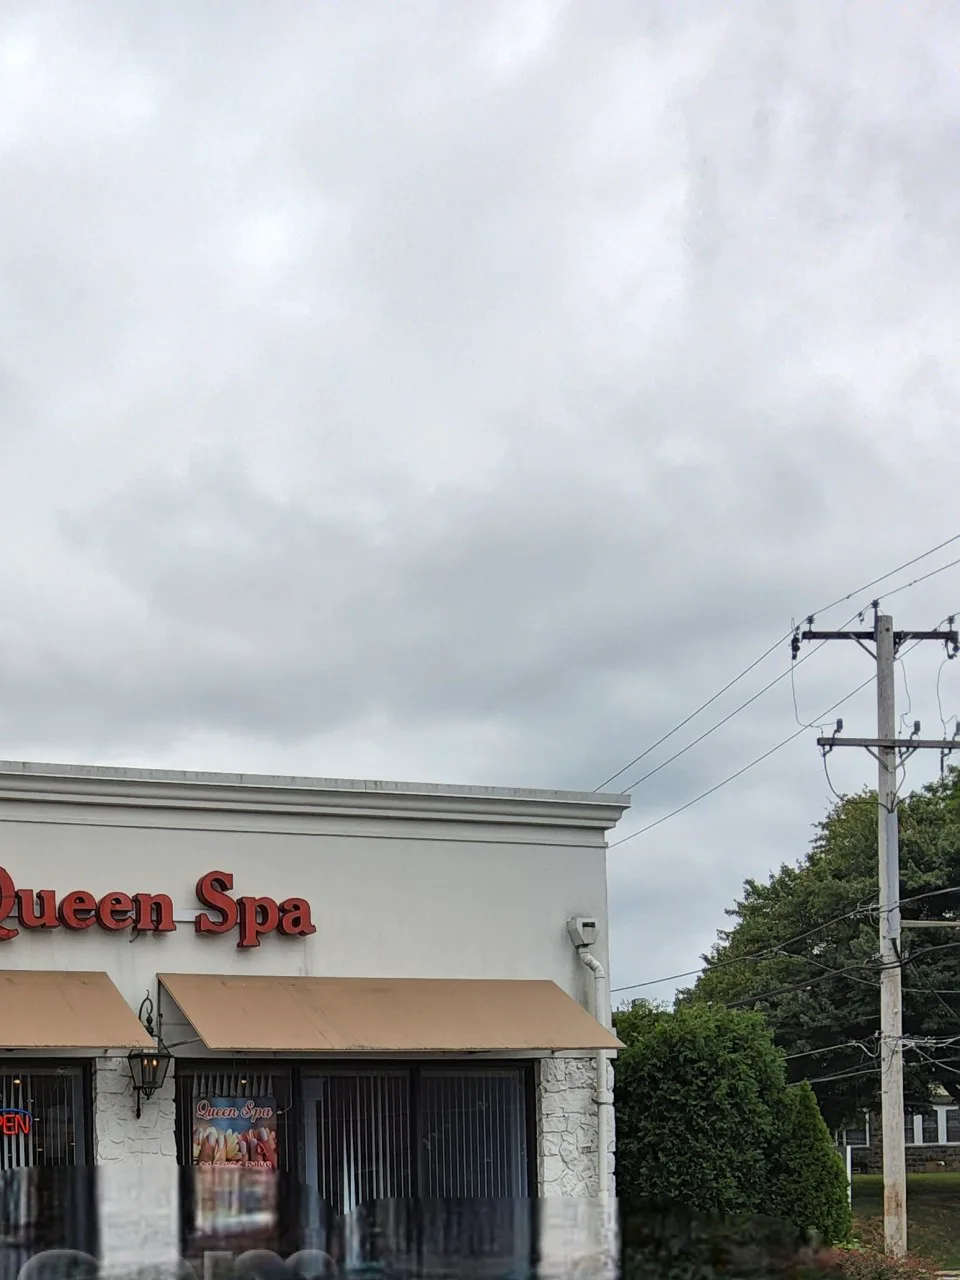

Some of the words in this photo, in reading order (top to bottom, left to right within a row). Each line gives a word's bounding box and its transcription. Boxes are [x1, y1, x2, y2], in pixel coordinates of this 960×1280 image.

[195, 870, 316, 948] Spa
[196, 1100, 239, 1120] Queen
[240, 1100, 274, 1122] Spa
